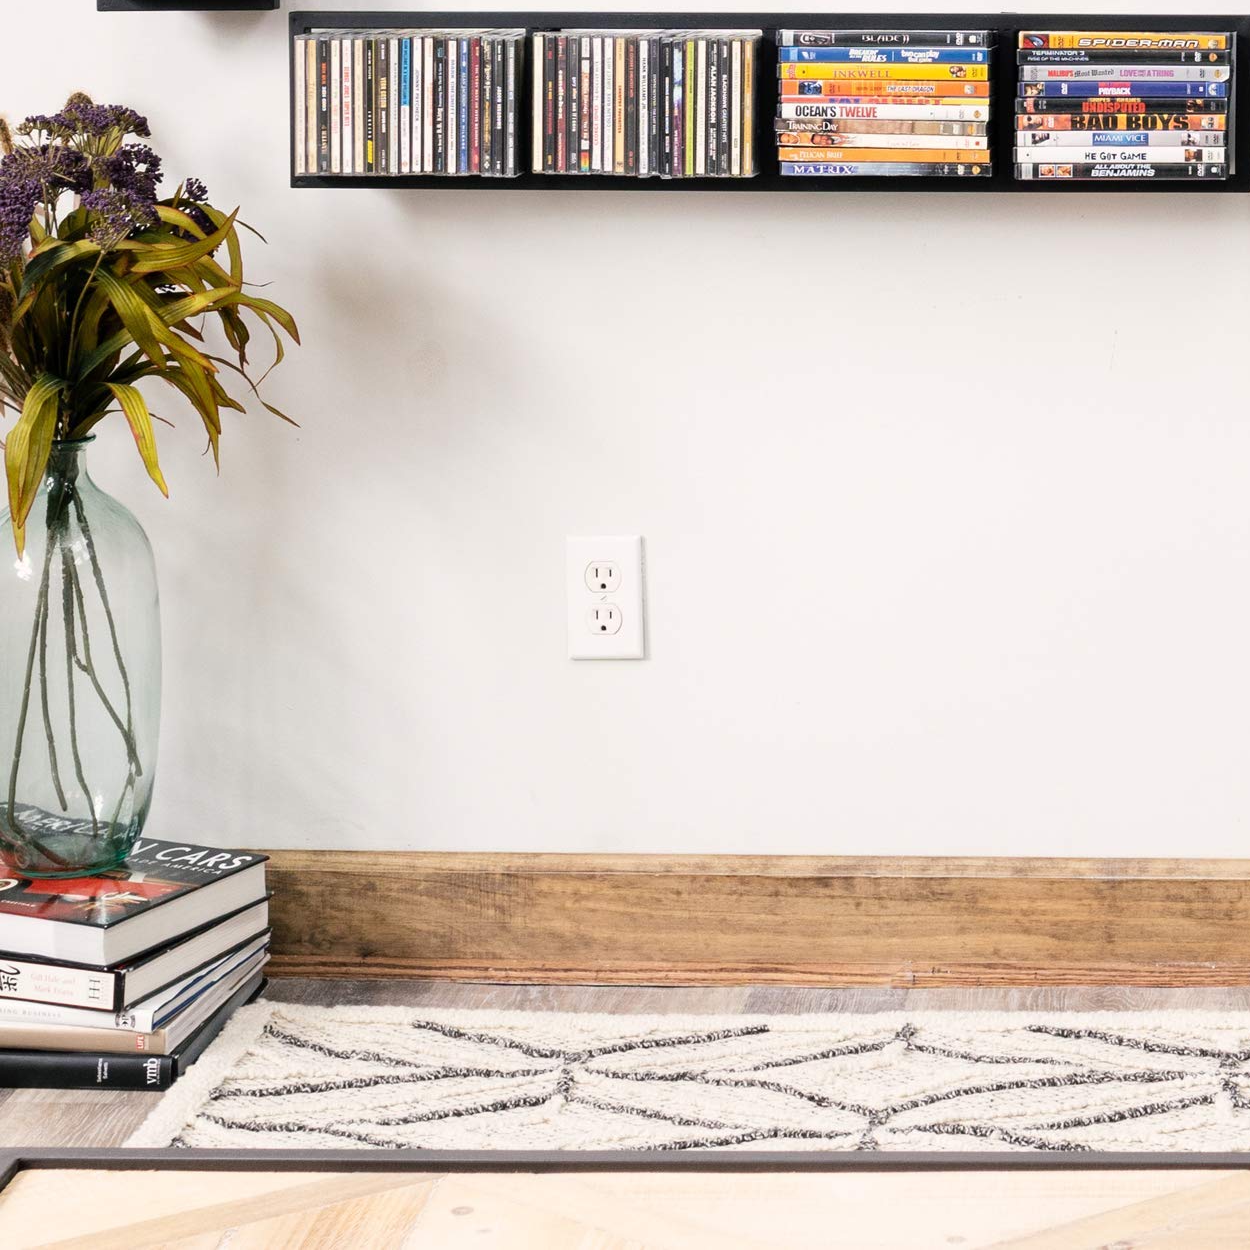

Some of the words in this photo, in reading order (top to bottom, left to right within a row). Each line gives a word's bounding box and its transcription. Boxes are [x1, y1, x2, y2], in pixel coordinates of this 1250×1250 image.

[1078, 38, 1199, 47] SPIDER-MAN
[833, 70, 891, 78] INKWELL
[795, 106, 836, 117] OCEAN'S
[839, 106, 877, 118] TWELVE
[1082, 102, 1145, 113] UNDISPUTED
[787, 121, 822, 130] TRAINING
[823, 121, 838, 131] DAY
[1071, 116, 1118, 129] BAD
[1126, 116, 1189, 129] BOYS
[826, 151, 843, 159] BRIEF
[1085, 152, 1097, 160] HE
[1100, 152, 1117, 160] GOT
[1120, 152, 1147, 160] GAME
[794, 165, 853, 174] MATRIX
[1091, 169, 1155, 177] BENJAMINS
[156, 846, 253, 871] CARS
[164, 862, 222, 876] AMERICA
[143, 1058, 158, 1084] vmb
